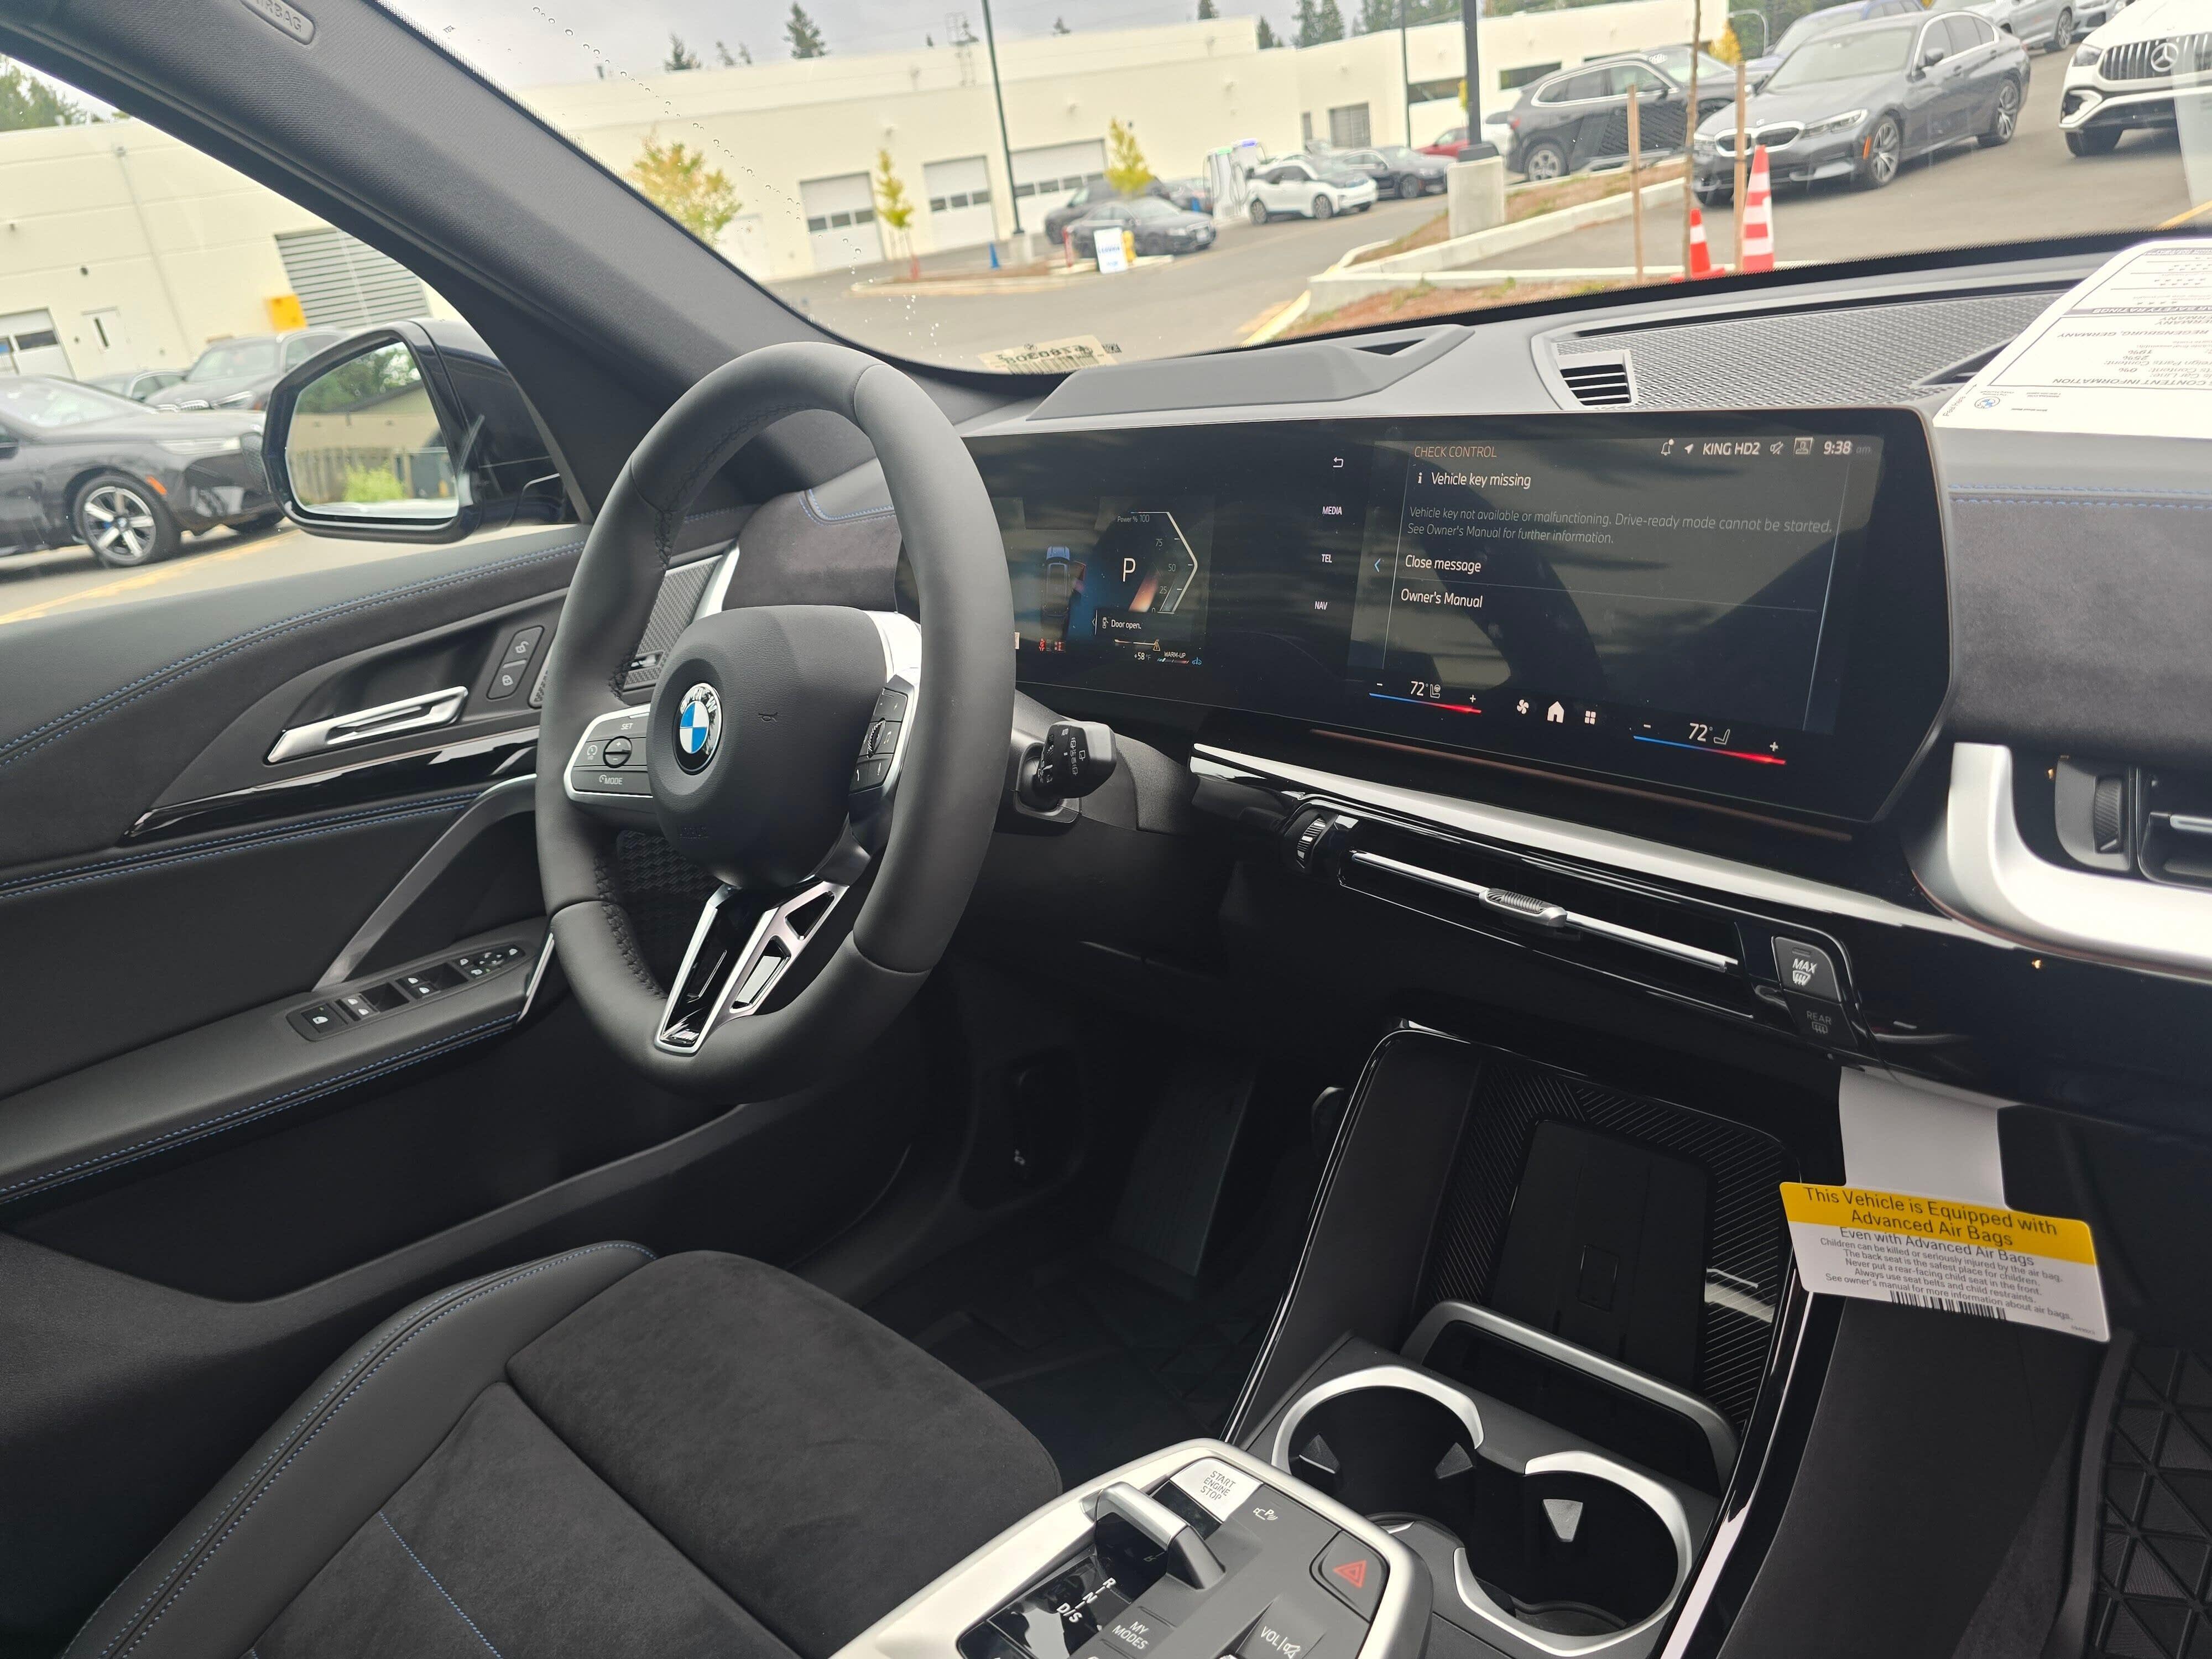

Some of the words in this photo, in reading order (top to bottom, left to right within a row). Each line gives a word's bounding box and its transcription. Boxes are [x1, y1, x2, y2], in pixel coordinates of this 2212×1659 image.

[256, 0, 302, 32] IRBAG
[1414, 446, 1447, 458] CHECK
[1448, 446, 1498, 458] CONTROL
[1703, 442, 1731, 456] KING
[1734, 442, 1761, 456] HD2
[1823, 440, 1852, 455] 9:38
[1431, 472, 1466, 486] Vehicle
[1469, 472, 1488, 488] key
[1490, 472, 1531, 489] missing
[1140, 514, 1150, 523] 100
[1322, 506, 1342, 515] MEDIA
[1410, 507, 1441, 518] Vehicle
[1442, 507, 1459, 520] key
[1460, 509, 1475, 520] not
[1478, 509, 1519, 522] available
[1522, 513, 1532, 522] or
[1534, 511, 1611, 528] malfunctioning.
[1615, 513, 1679, 530] Drive-ready
[1682, 516, 1715, 529] mode
[1719, 518, 1761, 531] cannot
[1765, 518, 1780, 532] be
[1783, 519, 1833, 534] started.
[1407, 522, 1425, 535] See
[1426, 523, 1463, 537] Owner's
[1466, 525, 1501, 539] Manual
[1503, 526, 1516, 539] for
[1518, 527, 1551, 542] further
[1552, 529, 1614, 544] information.
[1155, 538, 1163, 547] 75
[1321, 554, 1332, 563] TEL
[1405, 554, 1432, 569] Close
[1434, 558, 1481, 575] message
[1123, 557, 1136, 582] P
[1168, 564, 1176, 572] 50
[1159, 586, 1167, 594] 25
[1400, 588, 1442, 604] Owner's
[1444, 592, 1483, 608] Manual
[1314, 601, 1328, 611] NAV
[1111, 619, 1125, 628] Door
[1125, 620, 1141, 630] open.
[620, 722, 634, 731] SET
[604, 777, 623, 785] MODE
[1793, 958, 1818, 974] MAX
[1806, 1010, 1832, 1025] REAR
[1803, 1186, 1839, 1203] This
[1842, 1190, 1905, 1212] Vehicle
[1909, 1198, 1923, 1214] is
[1928, 1201, 2013, 1228] Equipped
[2017, 1218, 2058, 1235] with
[1852, 1209, 1934, 1234] Advanced
[1939, 1221, 1963, 1238] Air
[1967, 1224, 2013, 1248] Bags
[1840, 1226, 1872, 1241] Even
[1874, 1232, 1902, 1245] with
[1906, 1235, 1971, 1255] Advanced
[1976, 1245, 1994, 1259] Air
[1997, 1248, 2034, 1267] Bags
[1820, 1237, 1856, 1248] Children
[1874, 1244, 1885, 1253] be
[1887, 1247, 1910, 1256] killed
[1922, 1252, 1963, 1266] seriously
[1964, 1257, 1996, 1270] injured
[1997, 1262, 2008, 1273] by
[2011, 1265, 2026, 1275] the
[2028, 1269, 2040, 1277] air
[1843, 1248, 1860, 1258] The
[1861, 1251, 1883, 1261] back
[1884, 1256, 1903, 1264] seat
[1913, 1259, 1928, 1267] the
[1929, 1262, 1957, 1272] safest
[1958, 1266, 1983, 1276] place
[1985, 1269, 1997, 1279] for
[2000, 1272, 2041, 1286] children.
[1845, 1258, 1870, 1268] Never
[1872, 1262, 1886, 1270] put
[1895, 1266, 1943, 1280] rear-facing
[1945, 1272, 1966, 1282] child
[1968, 1276, 1989, 1286] seat
[1990, 1279, 1999, 1287] in
[2000, 1281, 2015, 1290] the
[2017, 1284, 2043, 1296] front.
[1855, 1267, 1885, 1279] Always
[1923, 1276, 1945, 1287] belts
[1947, 1282, 1964, 1291] and
[1966, 1285, 1988, 1294] child
[1990, 1289, 2037, 1303] restraints.
[1825, 1273, 1843, 1282] See
[1844, 1277, 1877, 1287] owner's
[1879, 1281, 1910, 1291] manual
[1912, 1284, 1924, 1293] for
[1951, 1291, 2004, 1306] information
[2005, 1300, 2032, 1311] about
[2034, 1305, 2045, 1313] air
[2047, 1307, 2074, 1320] bags.
[1203, 1477, 1230, 1496] ENGINE
[1210, 1470, 1237, 1488] START
[1200, 1486, 1222, 1501] STOP
[1103, 1577, 1117, 1589] R
[1082, 1592, 1098, 1604] N
[1056, 1603, 1083, 1623] D/S
[1129, 1621, 1149, 1635] MY
[1112, 1624, 1150, 1650] MODES
